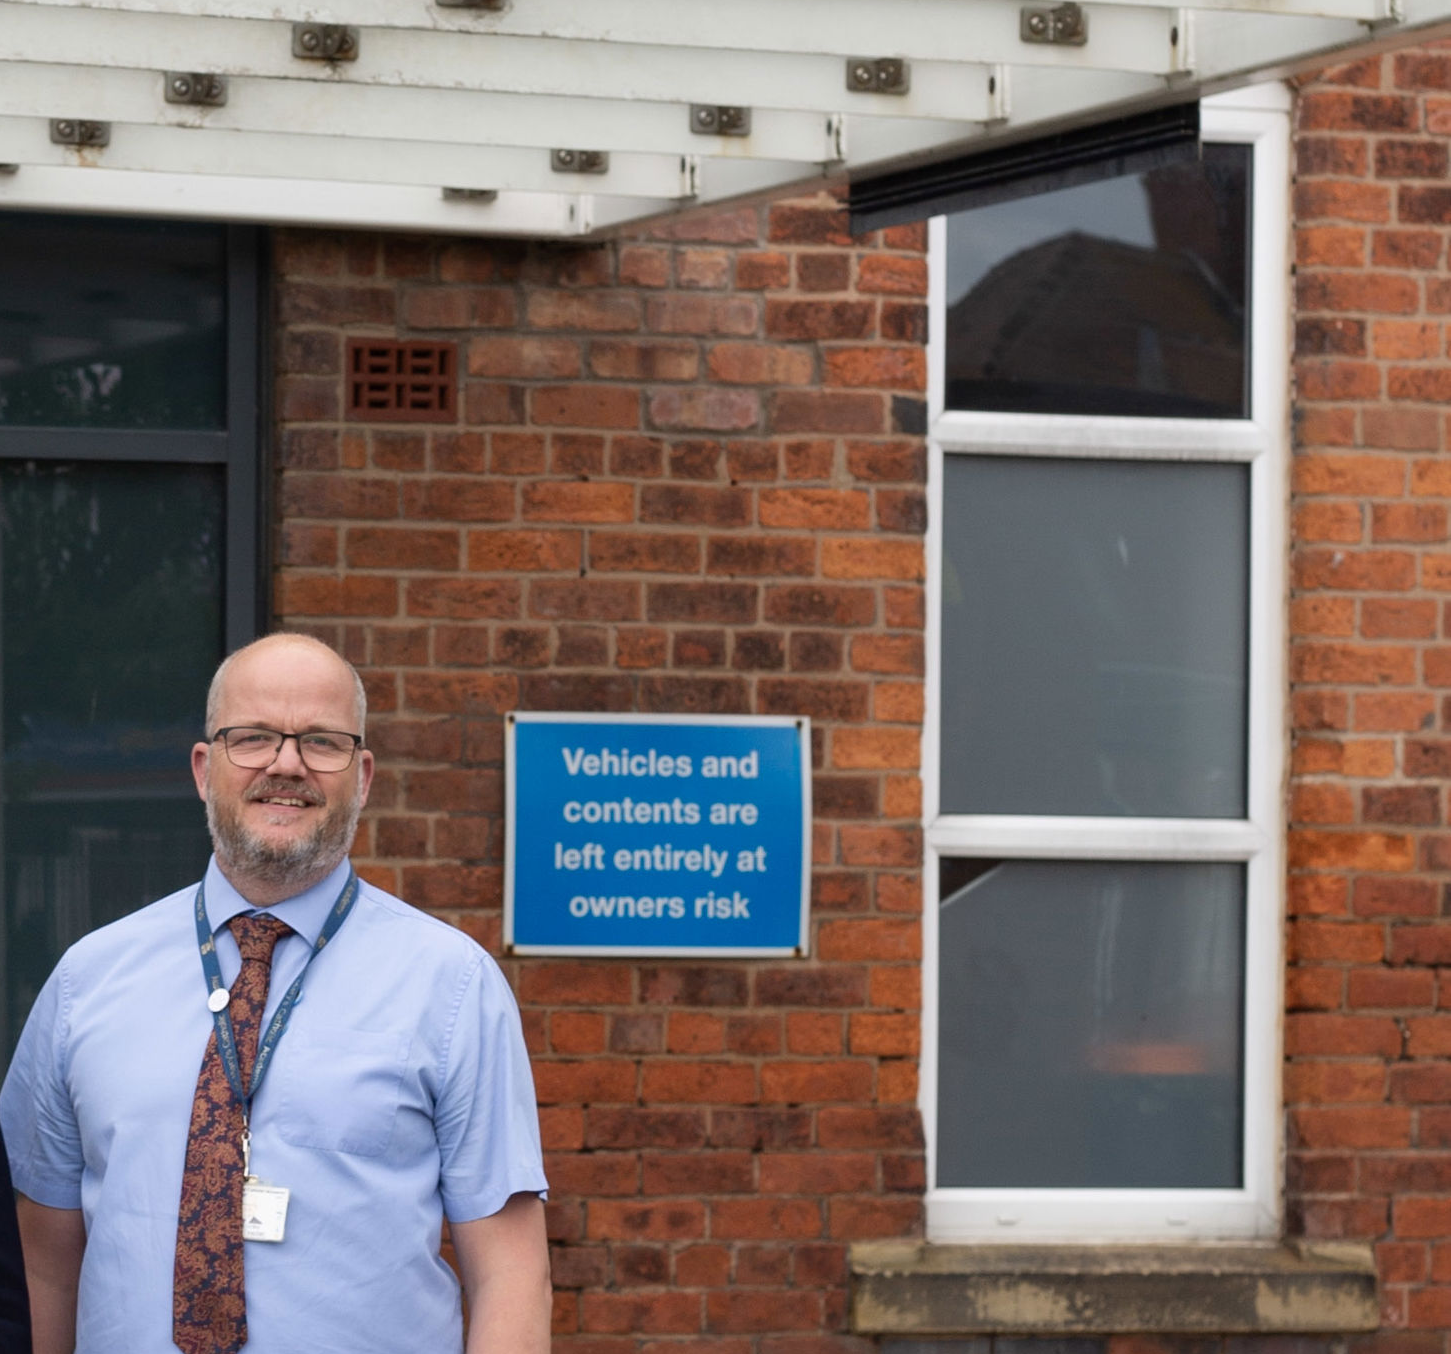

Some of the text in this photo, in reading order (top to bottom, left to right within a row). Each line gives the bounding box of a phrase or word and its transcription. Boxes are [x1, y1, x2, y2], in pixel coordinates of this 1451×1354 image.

[562, 746, 759, 779] Vehicles and
[563, 797, 758, 825] contents are
[554, 842, 767, 877] left entirely at
[569, 891, 750, 919] owners risk
